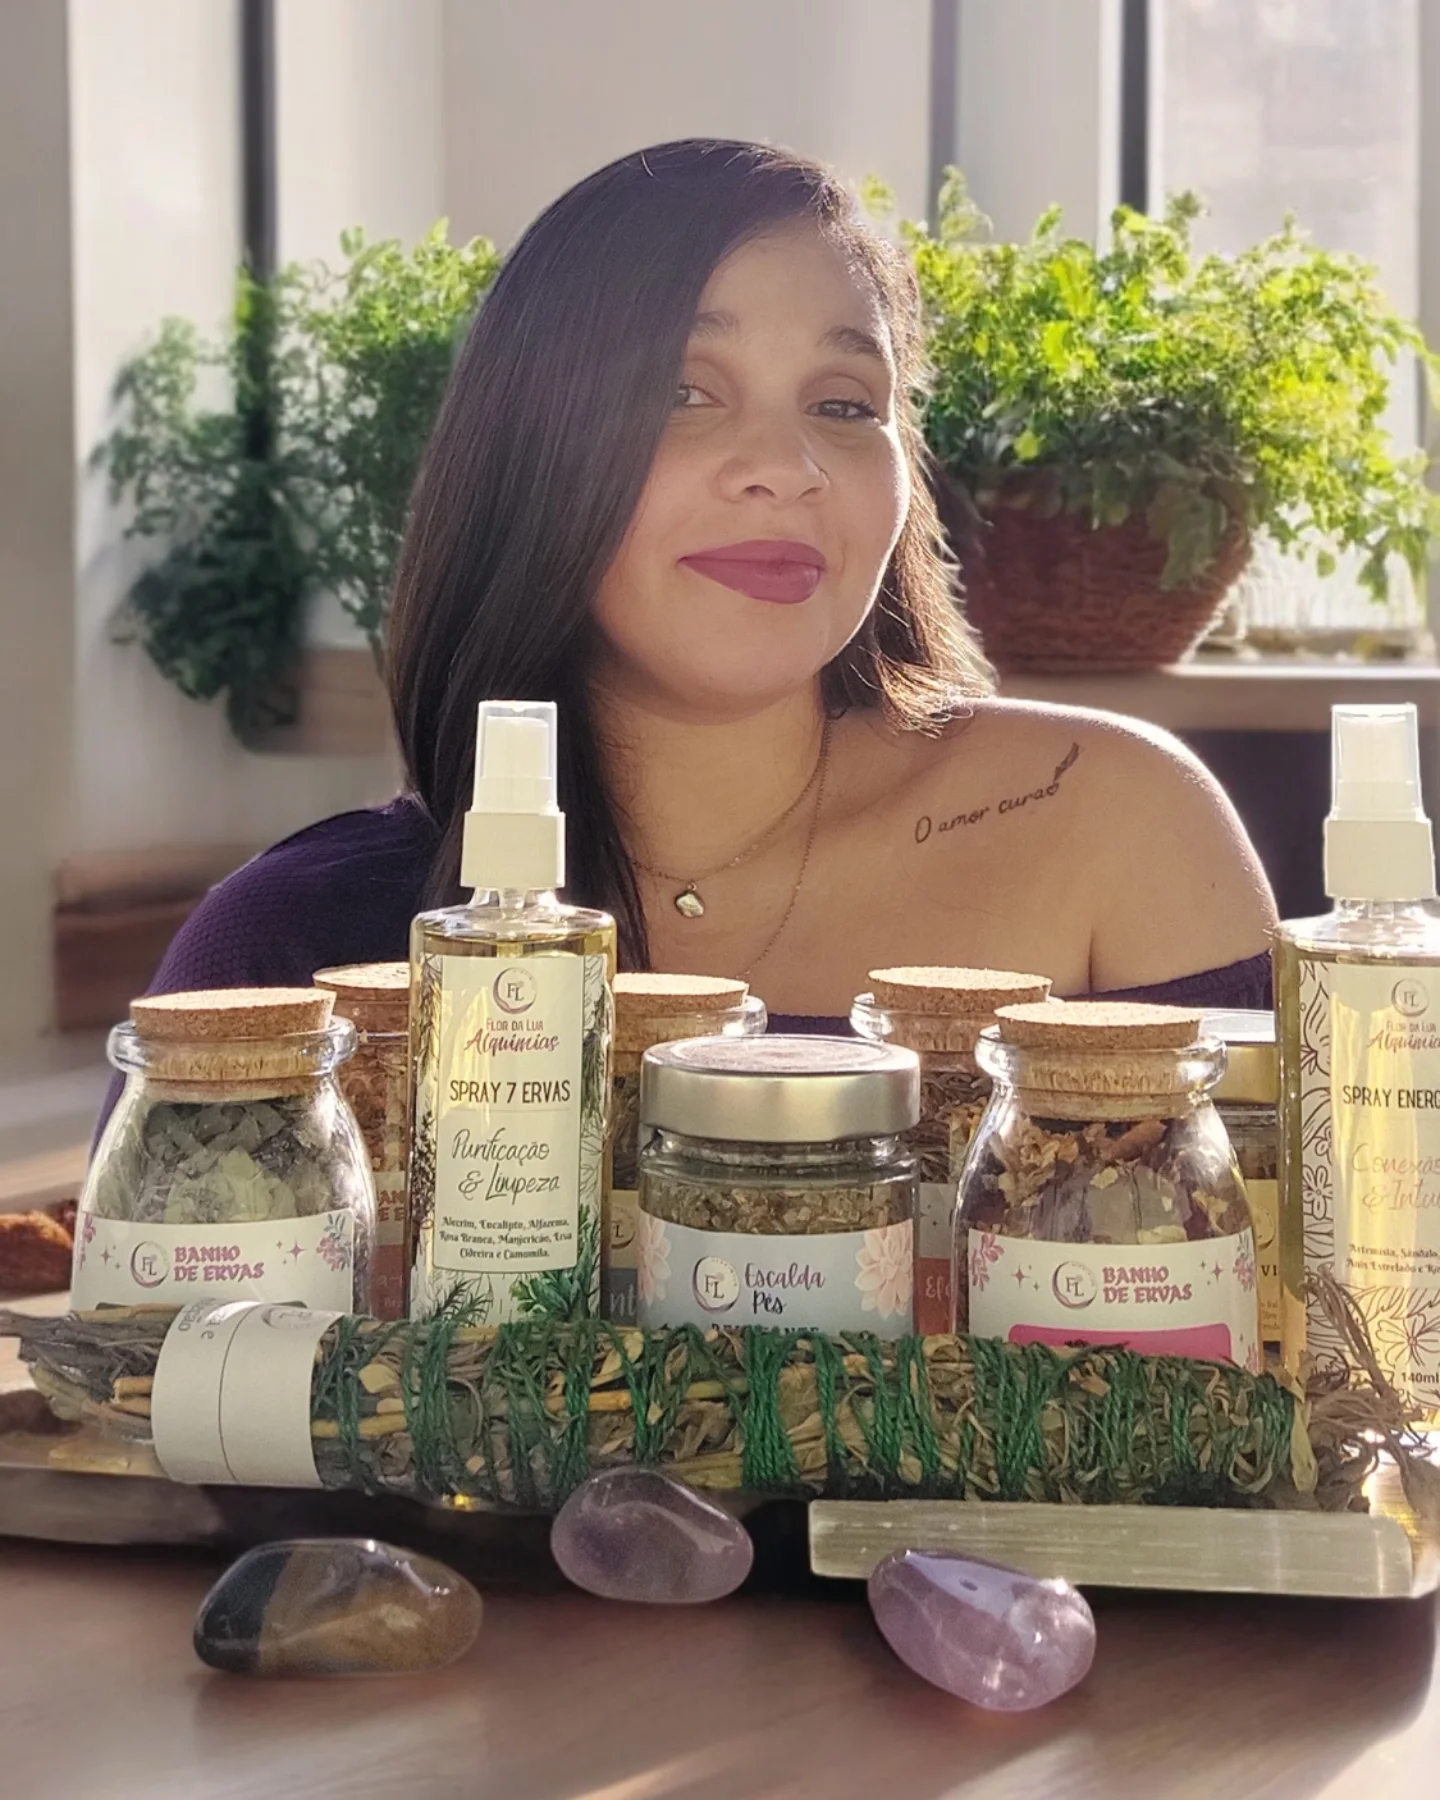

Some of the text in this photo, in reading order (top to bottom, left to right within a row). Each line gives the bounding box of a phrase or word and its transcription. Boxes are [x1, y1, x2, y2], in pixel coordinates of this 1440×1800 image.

[915, 816, 932, 844] O
[938, 807, 990, 832] amor
[464, 1028, 560, 1057] Alquimias
[449, 1080, 571, 1103] SPRAY 7 ERVAS
[1343, 1085, 1391, 1107] SPRAY
[451, 1127, 550, 1167] Purificação
[458, 1162, 560, 1205] & Limpeza
[174, 1245, 241, 1264] BANHO
[174, 1262, 265, 1282] DE ERVAS
[744, 1262, 826, 1291] Escalda
[1102, 1266, 1169, 1285] BANHO
[752, 1289, 787, 1315] Pés
[1103, 1283, 1193, 1304] DE ERVAS
[1401, 1371, 1440, 1384] 140ml
